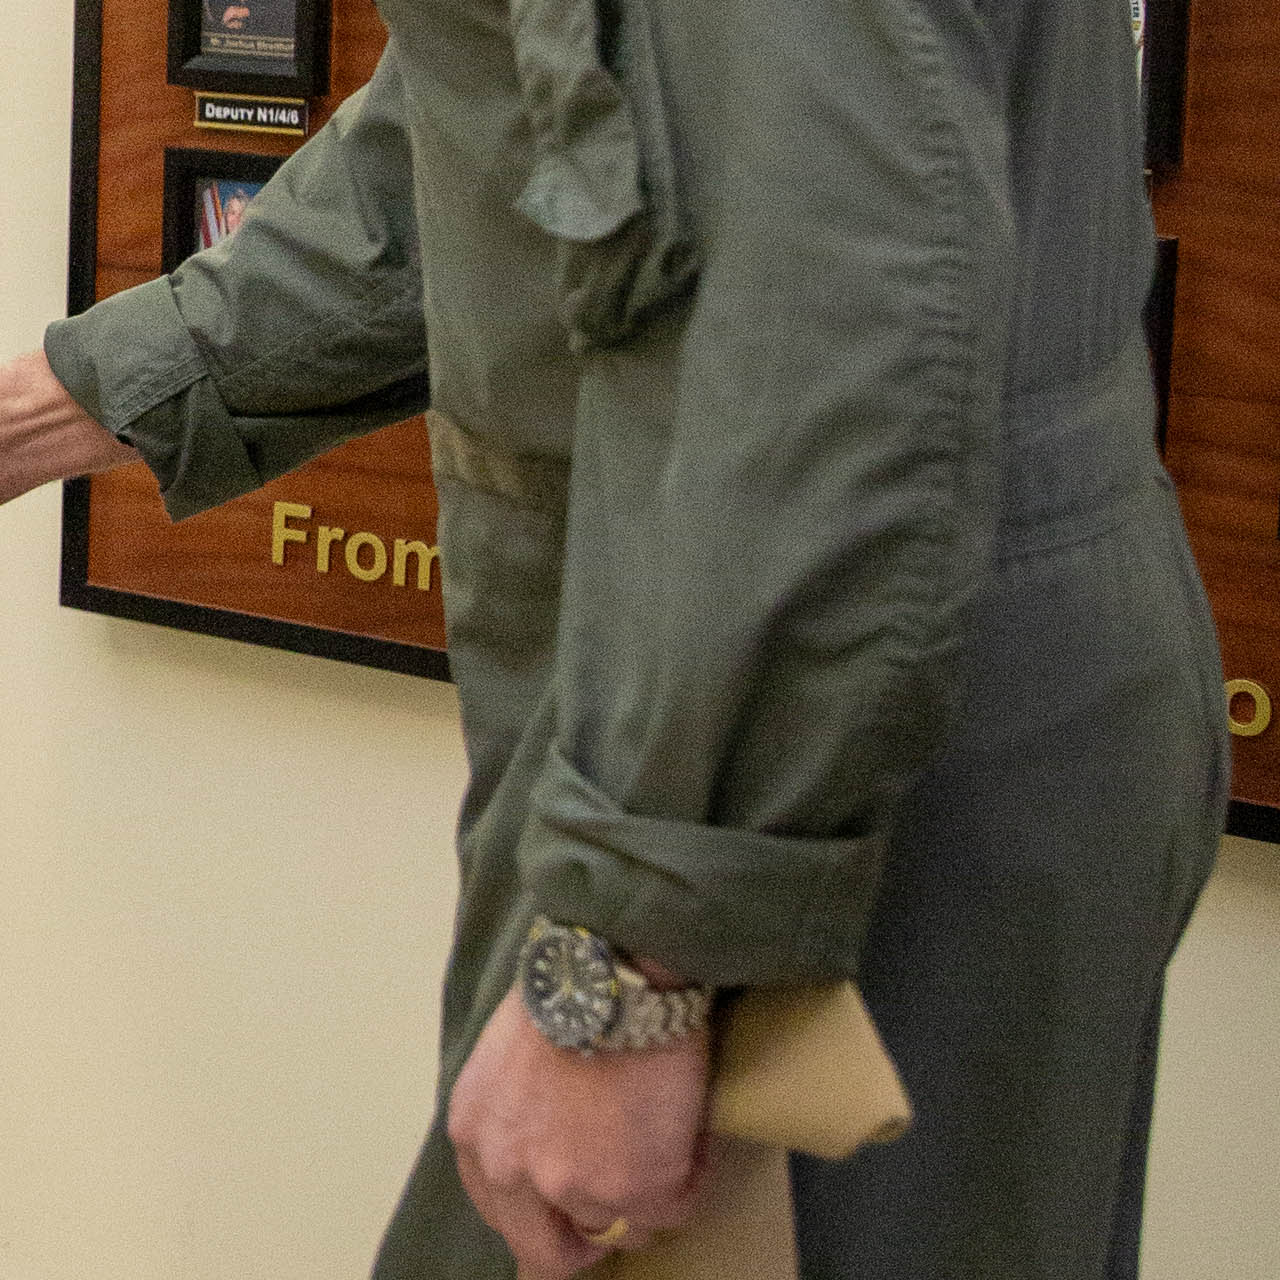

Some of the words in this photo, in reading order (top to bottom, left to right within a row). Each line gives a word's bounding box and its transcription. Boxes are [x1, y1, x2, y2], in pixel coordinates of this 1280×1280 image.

[205, 102, 254, 120] DEPUTY
[257, 106, 299, 125] N1/4/6
[271, 500, 441, 592] From
